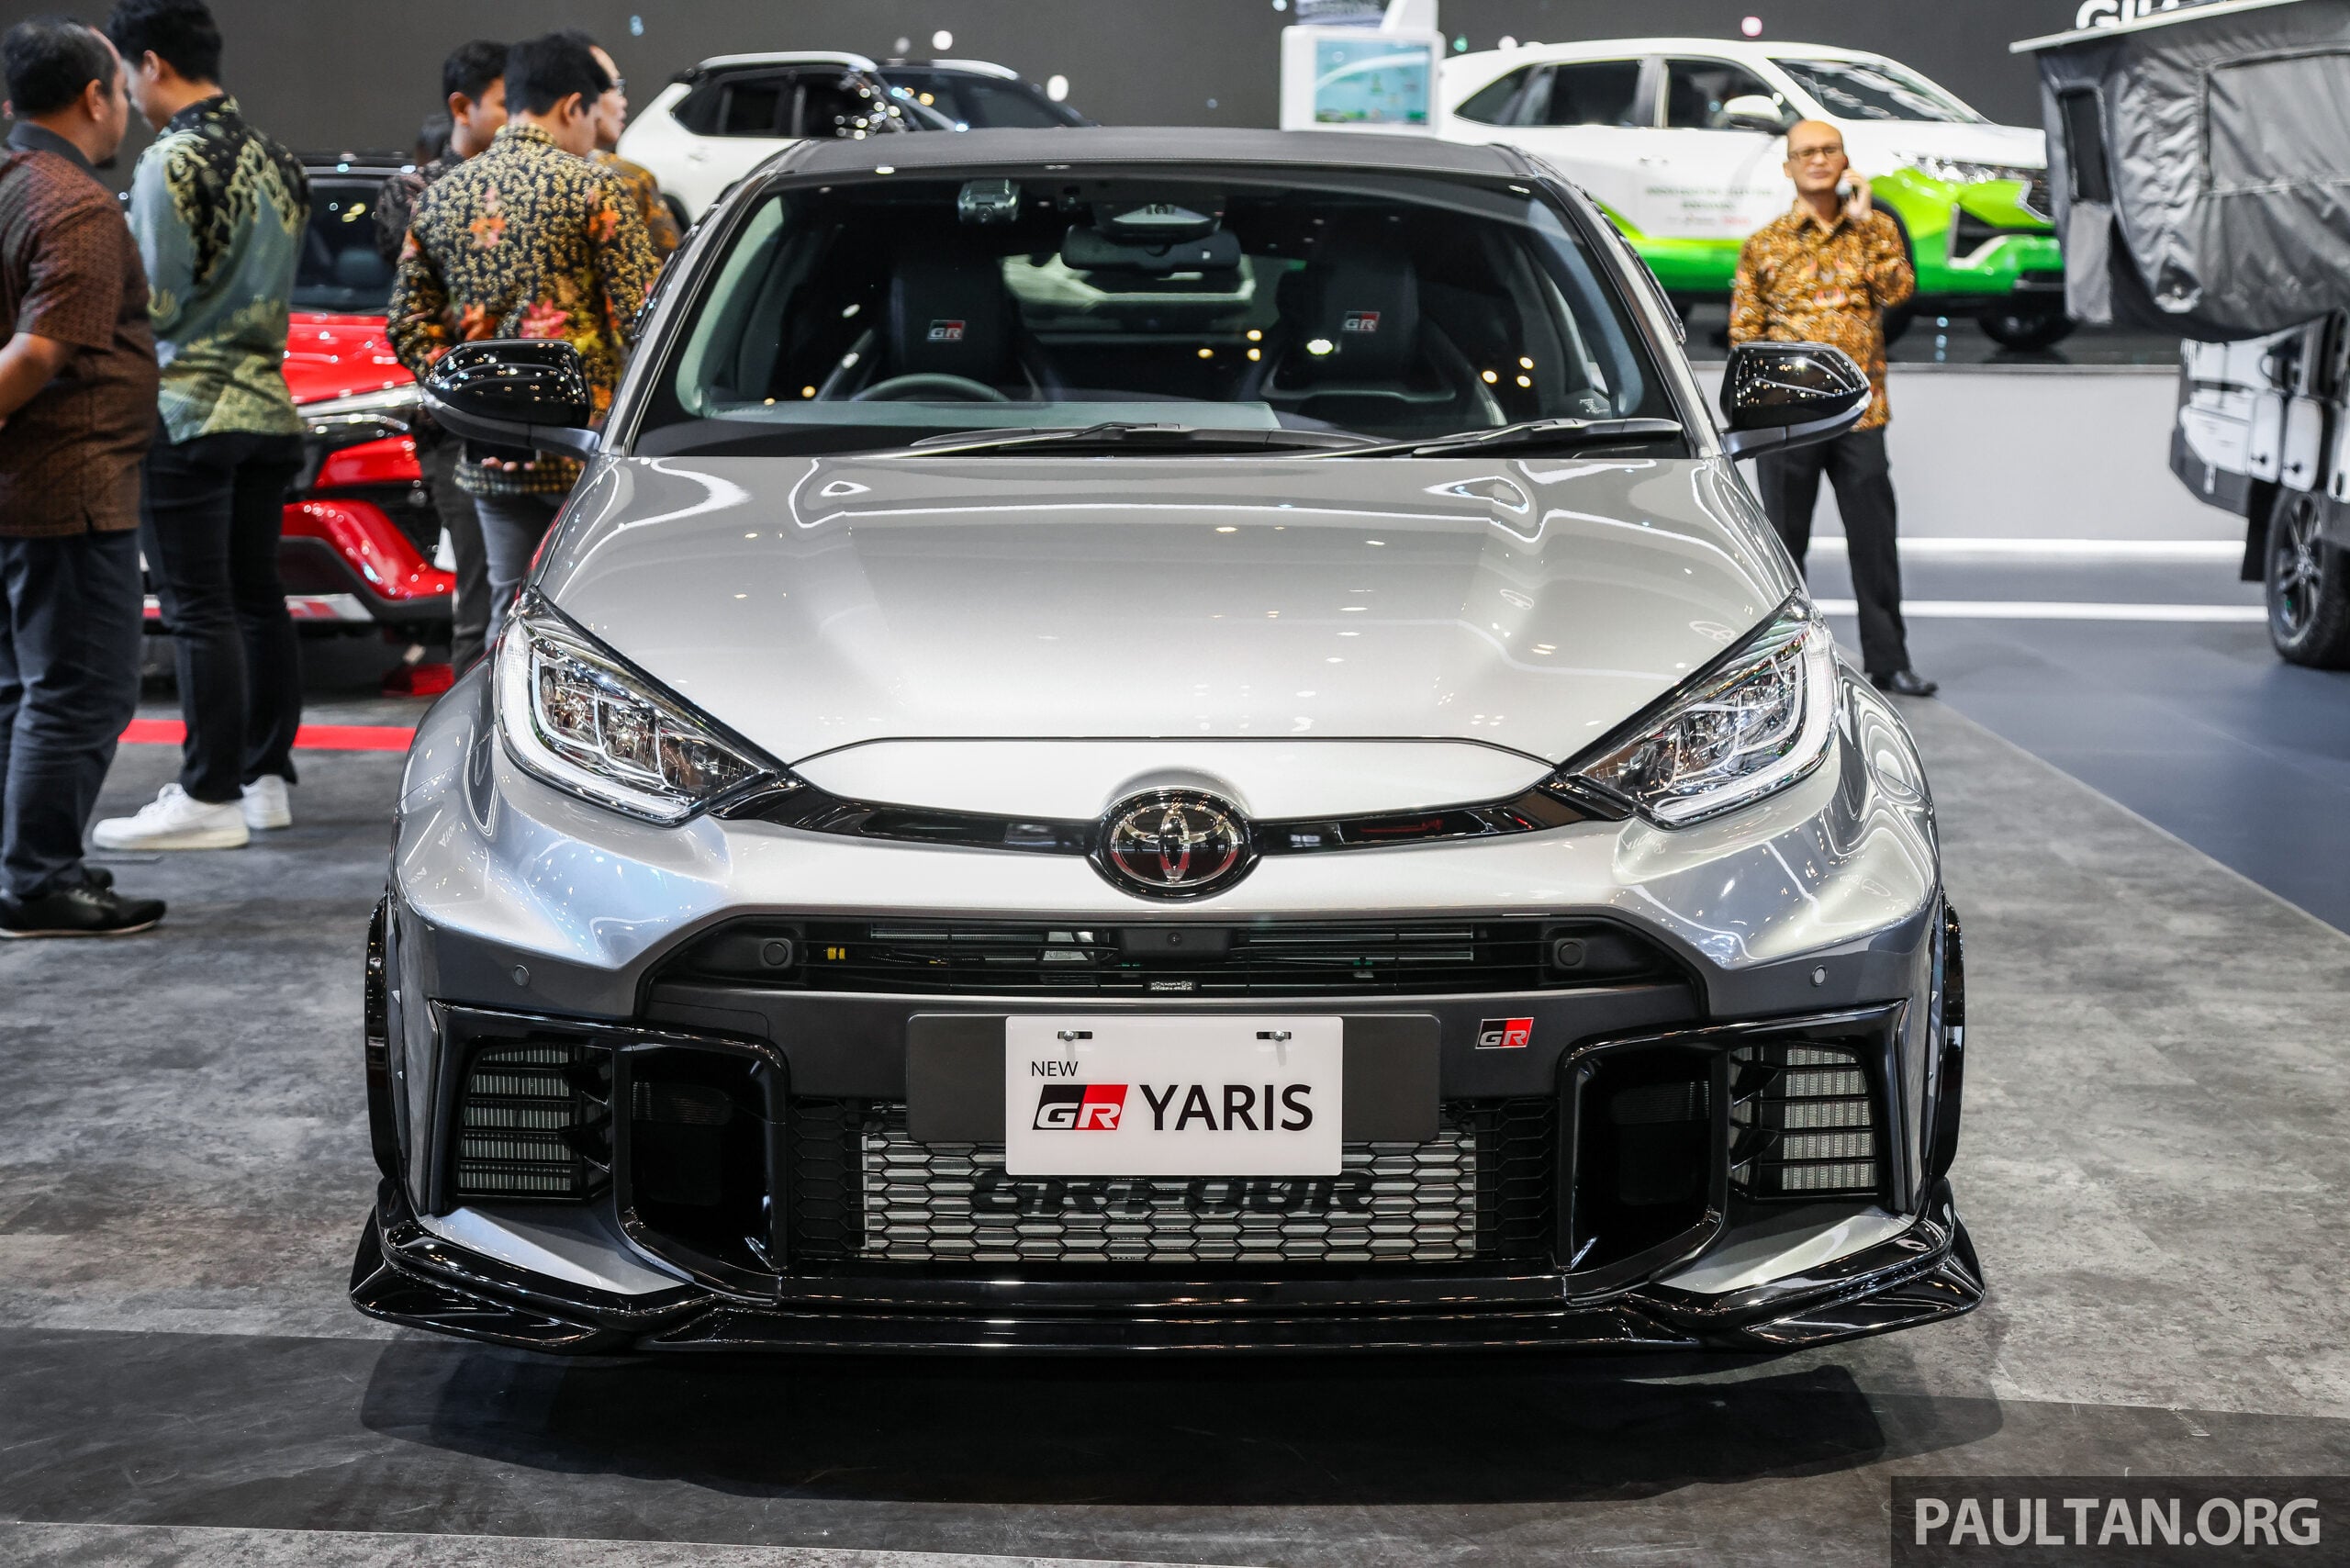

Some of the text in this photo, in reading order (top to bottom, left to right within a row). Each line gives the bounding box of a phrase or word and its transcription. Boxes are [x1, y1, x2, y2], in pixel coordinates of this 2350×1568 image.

[1031, 1060, 1079, 1077] NEW
[1035, 1084, 1314, 1131] GR YARIS
